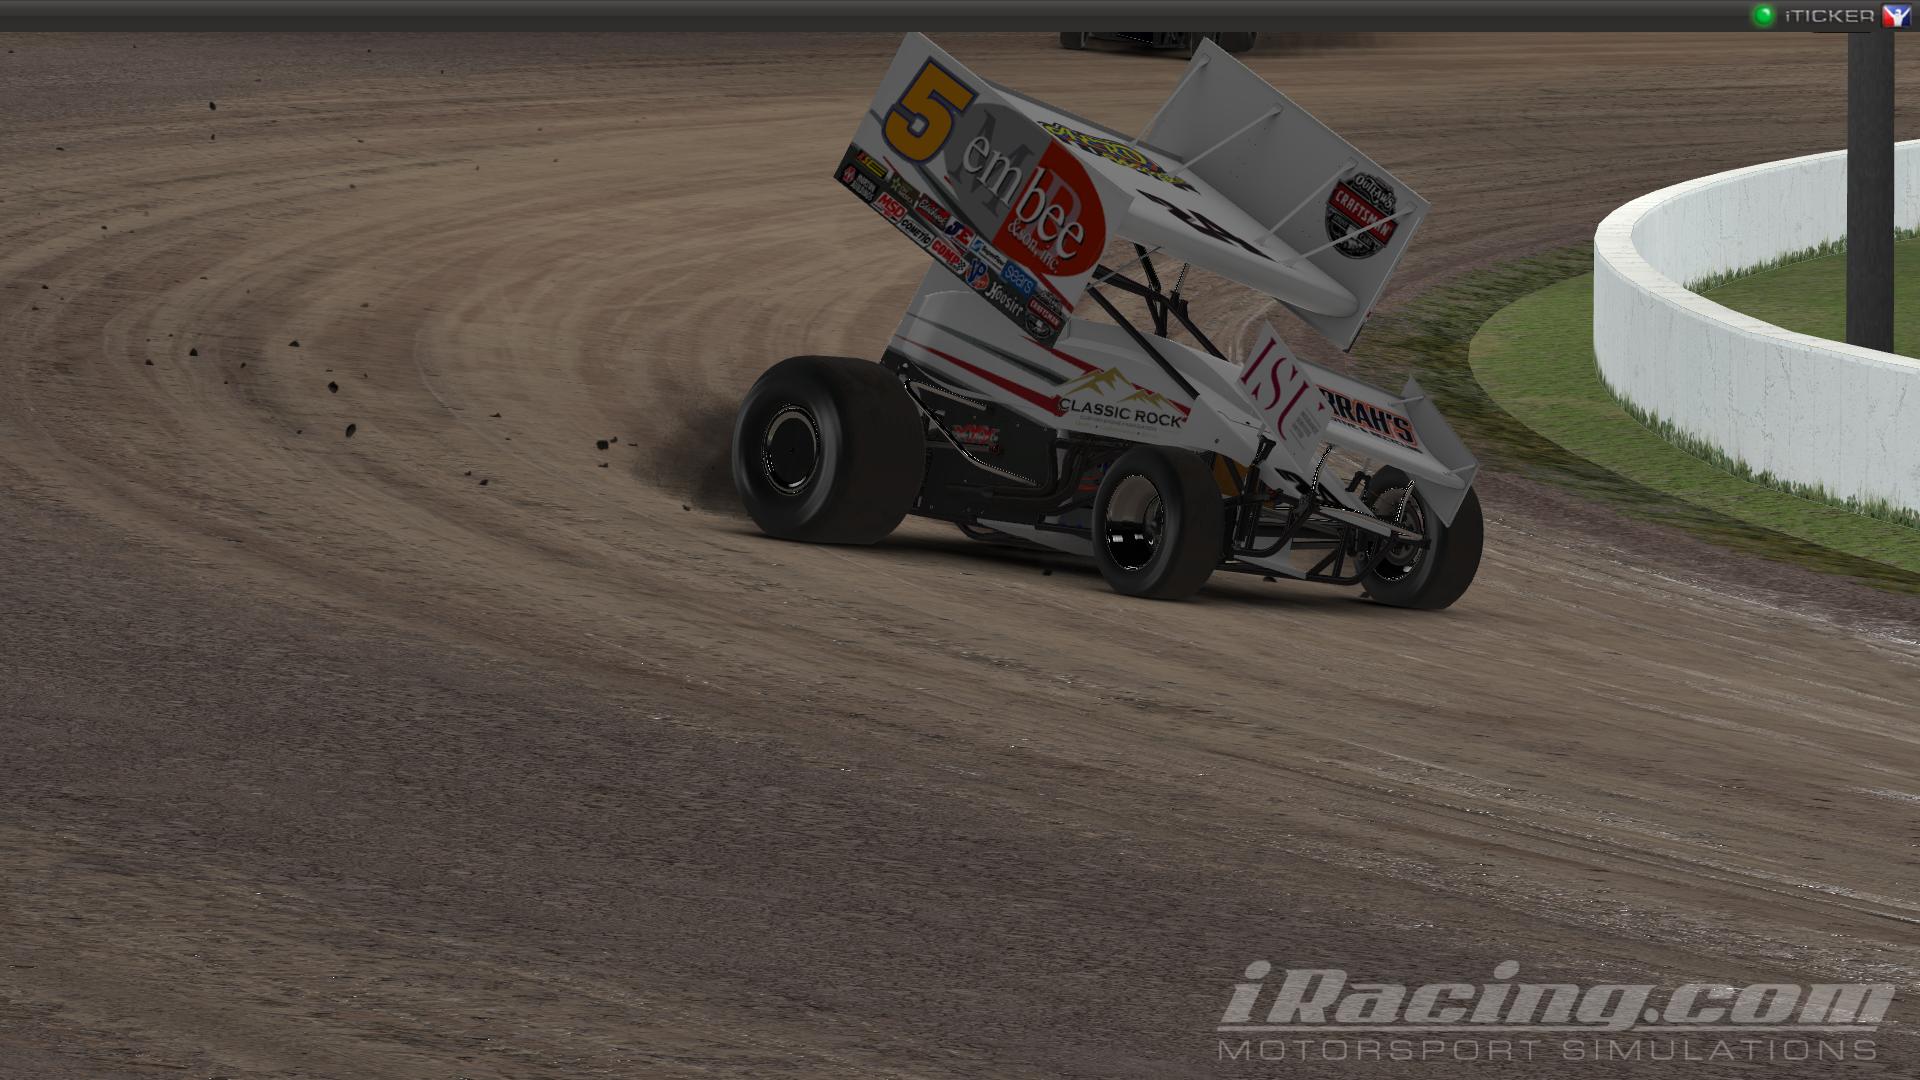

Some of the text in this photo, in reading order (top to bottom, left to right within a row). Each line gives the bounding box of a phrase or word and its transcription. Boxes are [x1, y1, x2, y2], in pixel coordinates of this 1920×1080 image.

[882, 56, 979, 166] 5
[877, 194, 906, 219] MSD
[963, 136, 1085, 260] embee
[1355, 174, 1395, 211] OUTLAWS
[1335, 189, 1392, 237] CRAFTSMAN
[931, 240, 961, 265] COMP
[1004, 264, 1034, 295] sears
[985, 281, 1024, 317] Hoosier
[1059, 397, 1131, 420] CLASSIC
[1134, 410, 1182, 428] ROCK
